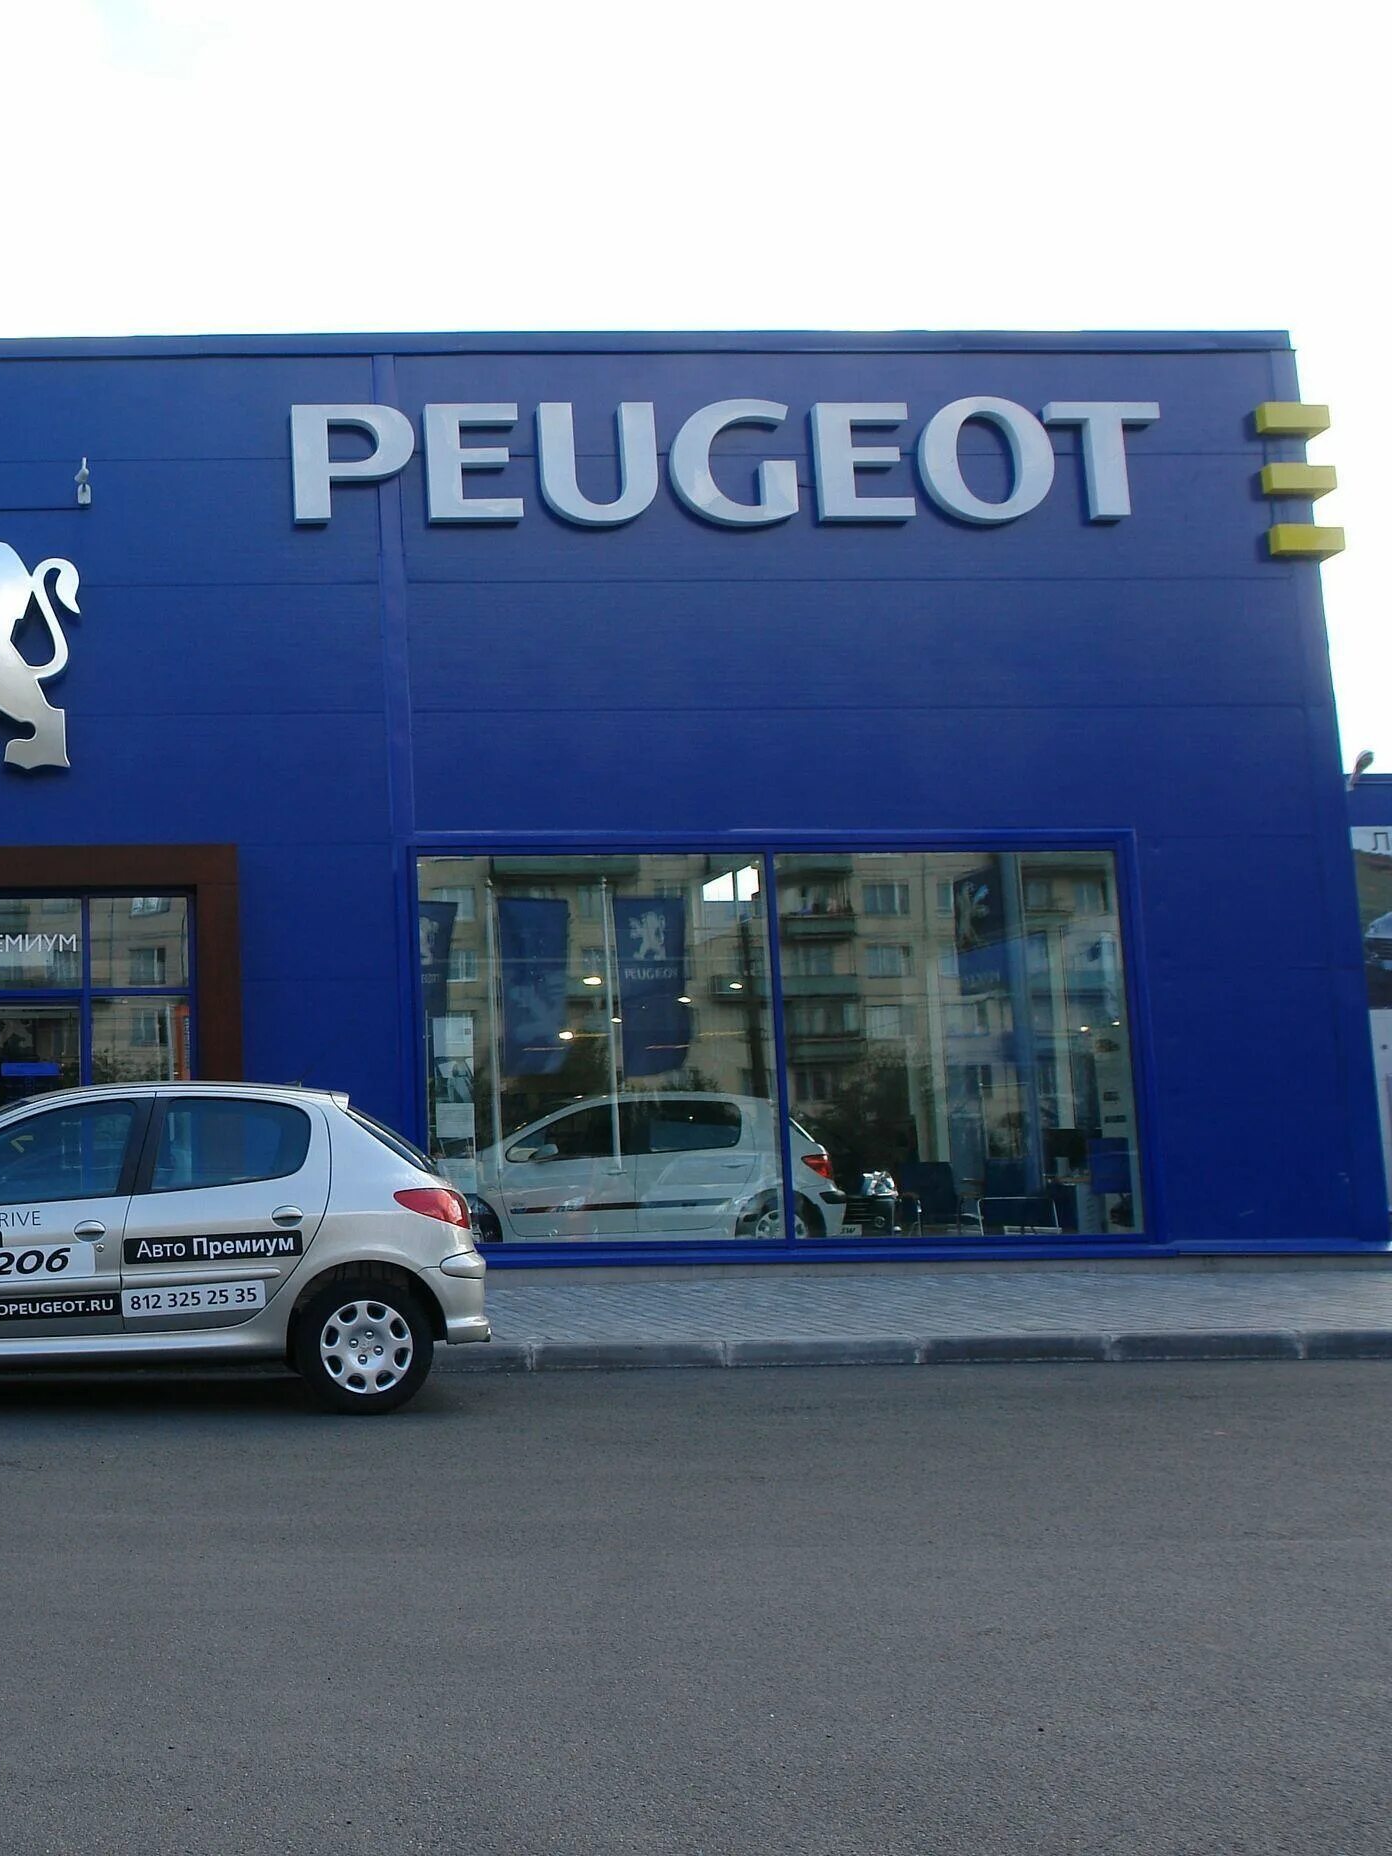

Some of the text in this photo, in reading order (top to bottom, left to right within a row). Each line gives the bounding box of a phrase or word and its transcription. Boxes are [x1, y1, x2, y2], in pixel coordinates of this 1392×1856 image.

[290, 396, 1161, 526] PEUGEOT
[136, 1237, 294, 1259] Авто Премиум
[130, 1287, 257, 1311] 812 325 25 35
